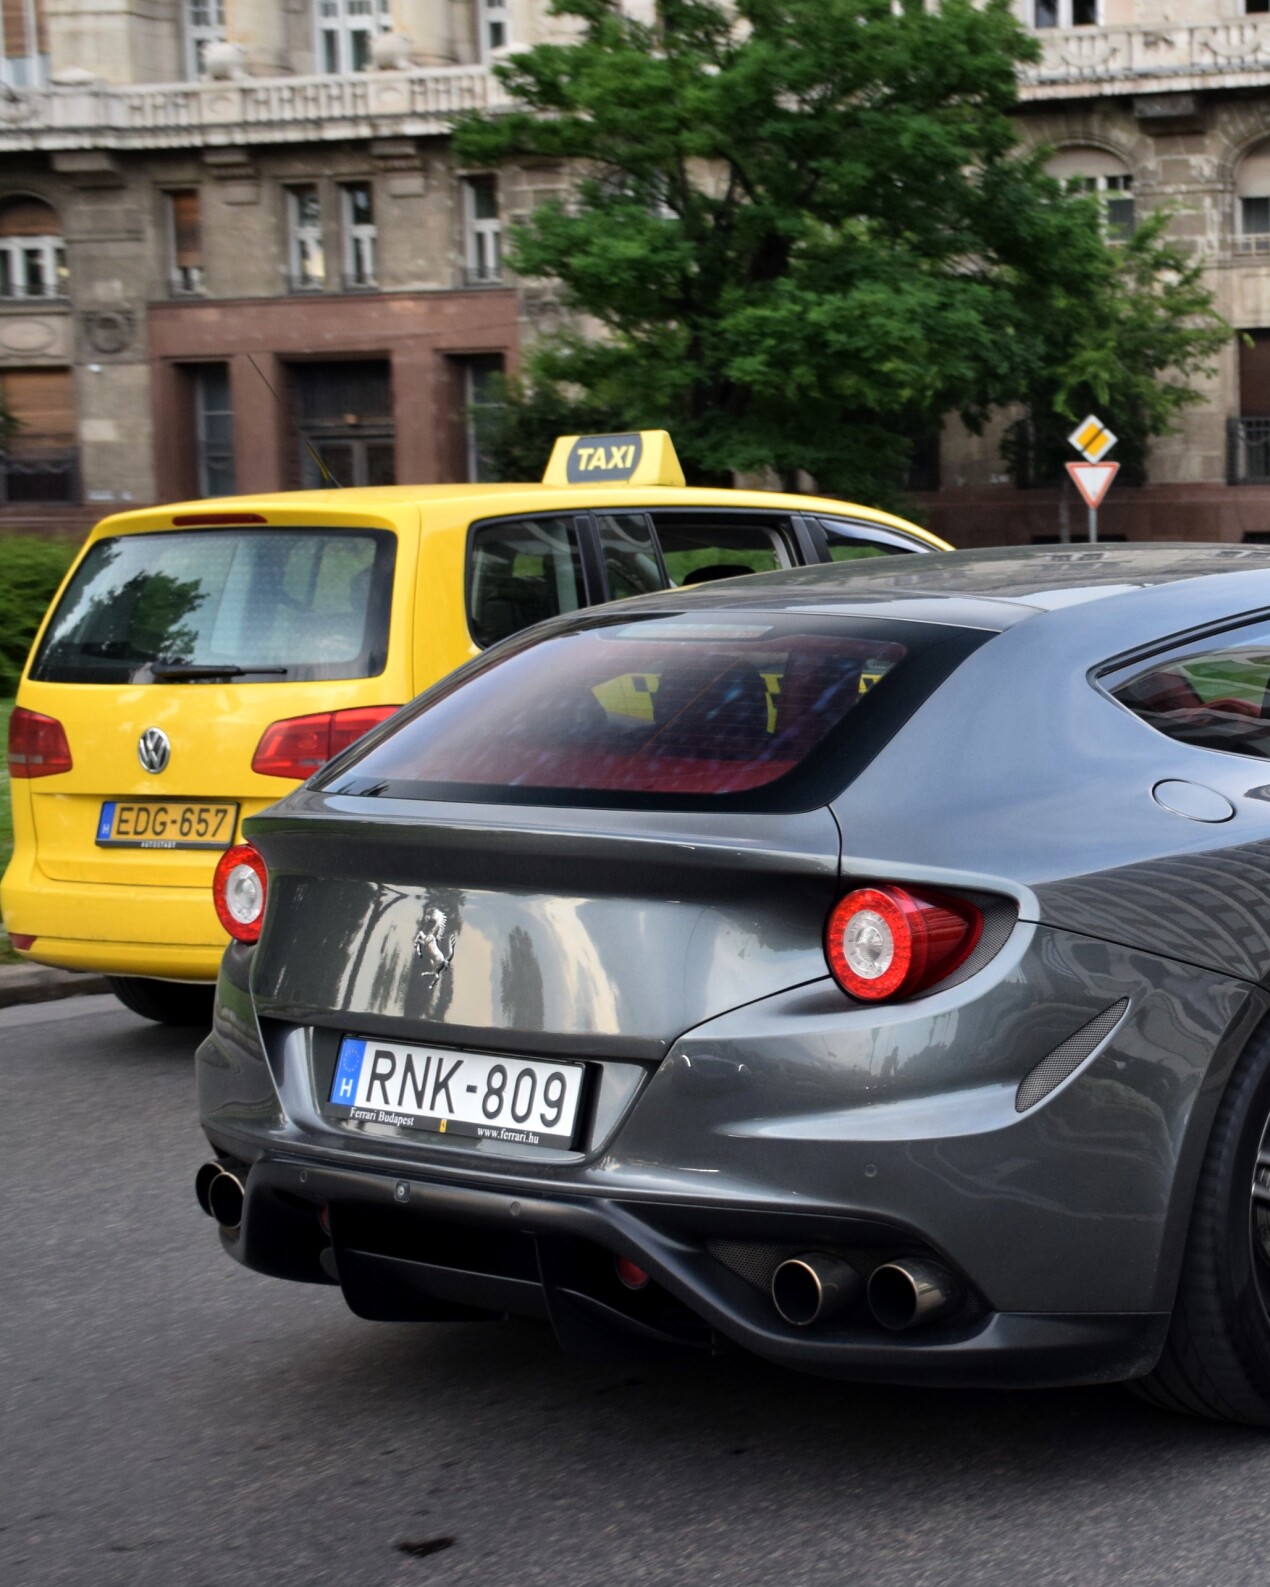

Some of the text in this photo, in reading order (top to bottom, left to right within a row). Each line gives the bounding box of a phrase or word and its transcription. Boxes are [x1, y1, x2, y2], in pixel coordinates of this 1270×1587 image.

[577, 445, 636, 471] TAXI
[116, 806, 228, 838] EDG-657
[339, 1049, 567, 1128] H RNK-809
[350, 1106, 414, 1127] Ferrari Budapest
[477, 1127, 540, 1144] www.ferrari.hu
